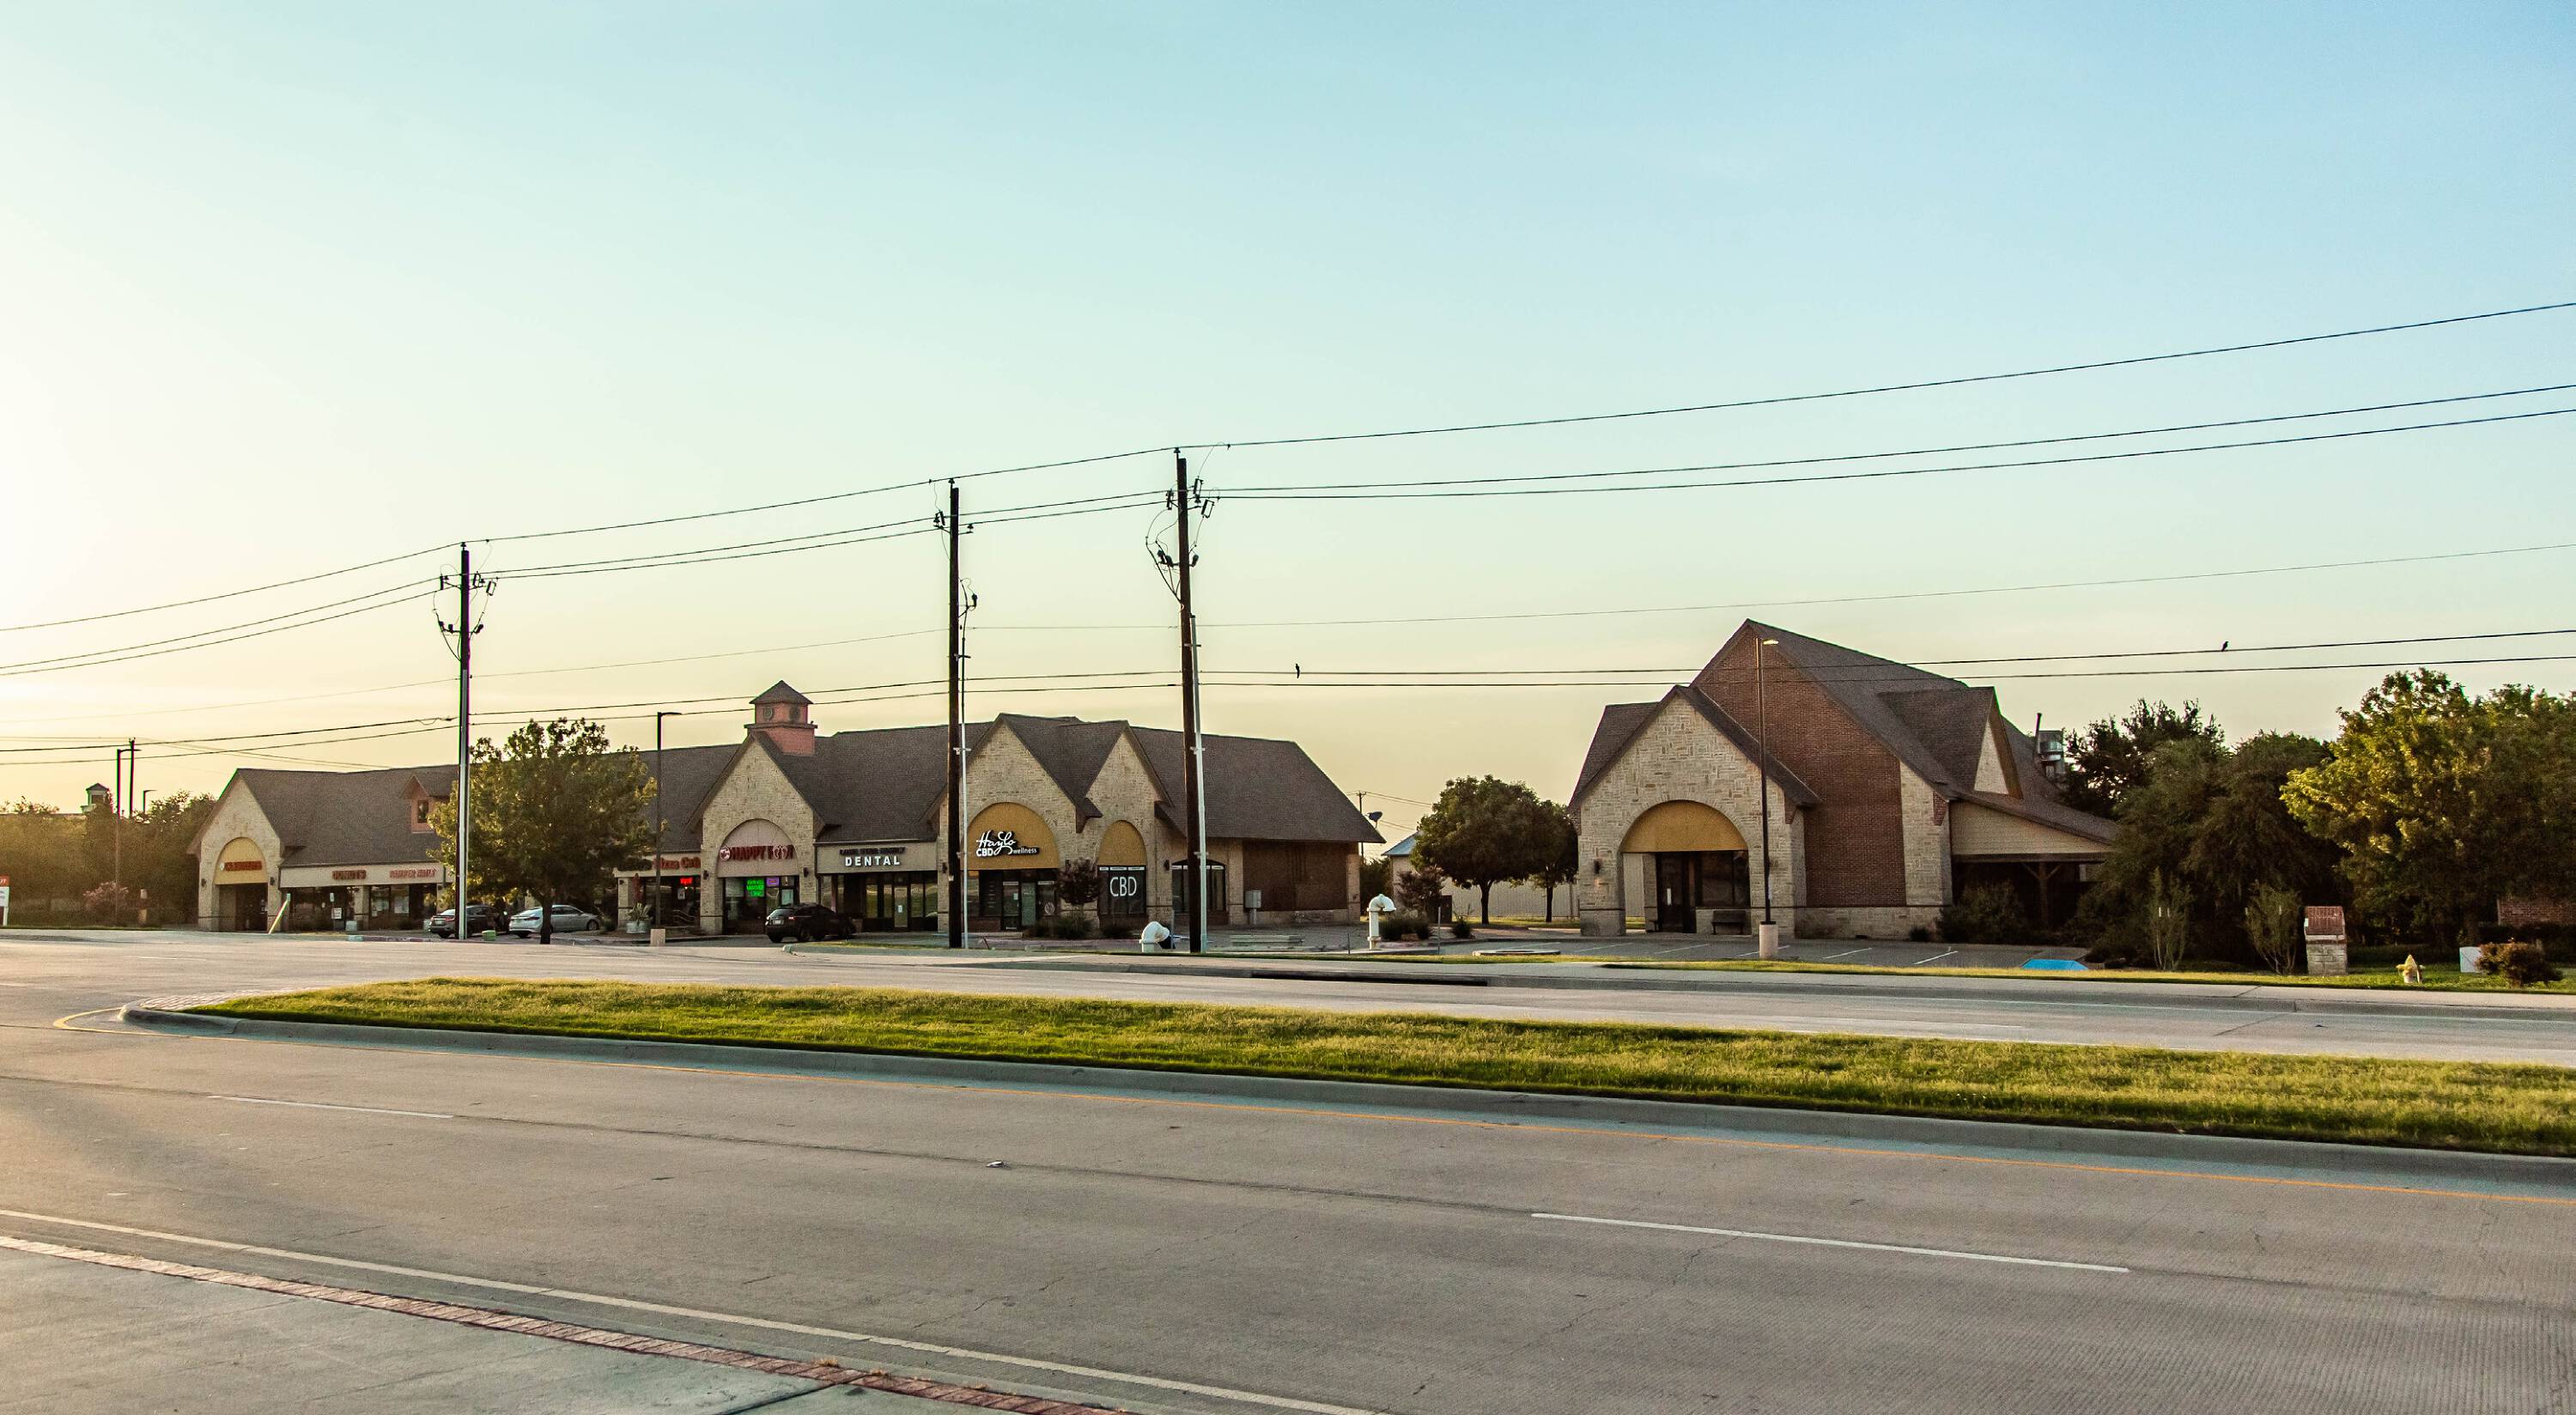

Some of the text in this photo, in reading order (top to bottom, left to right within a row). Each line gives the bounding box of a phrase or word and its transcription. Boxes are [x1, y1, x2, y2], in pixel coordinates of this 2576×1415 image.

[975, 830, 1017, 855] Haylo
[975, 847, 993, 857] CBD
[845, 855, 900, 866] DENTAL
[1109, 877, 1137, 896] CBD
